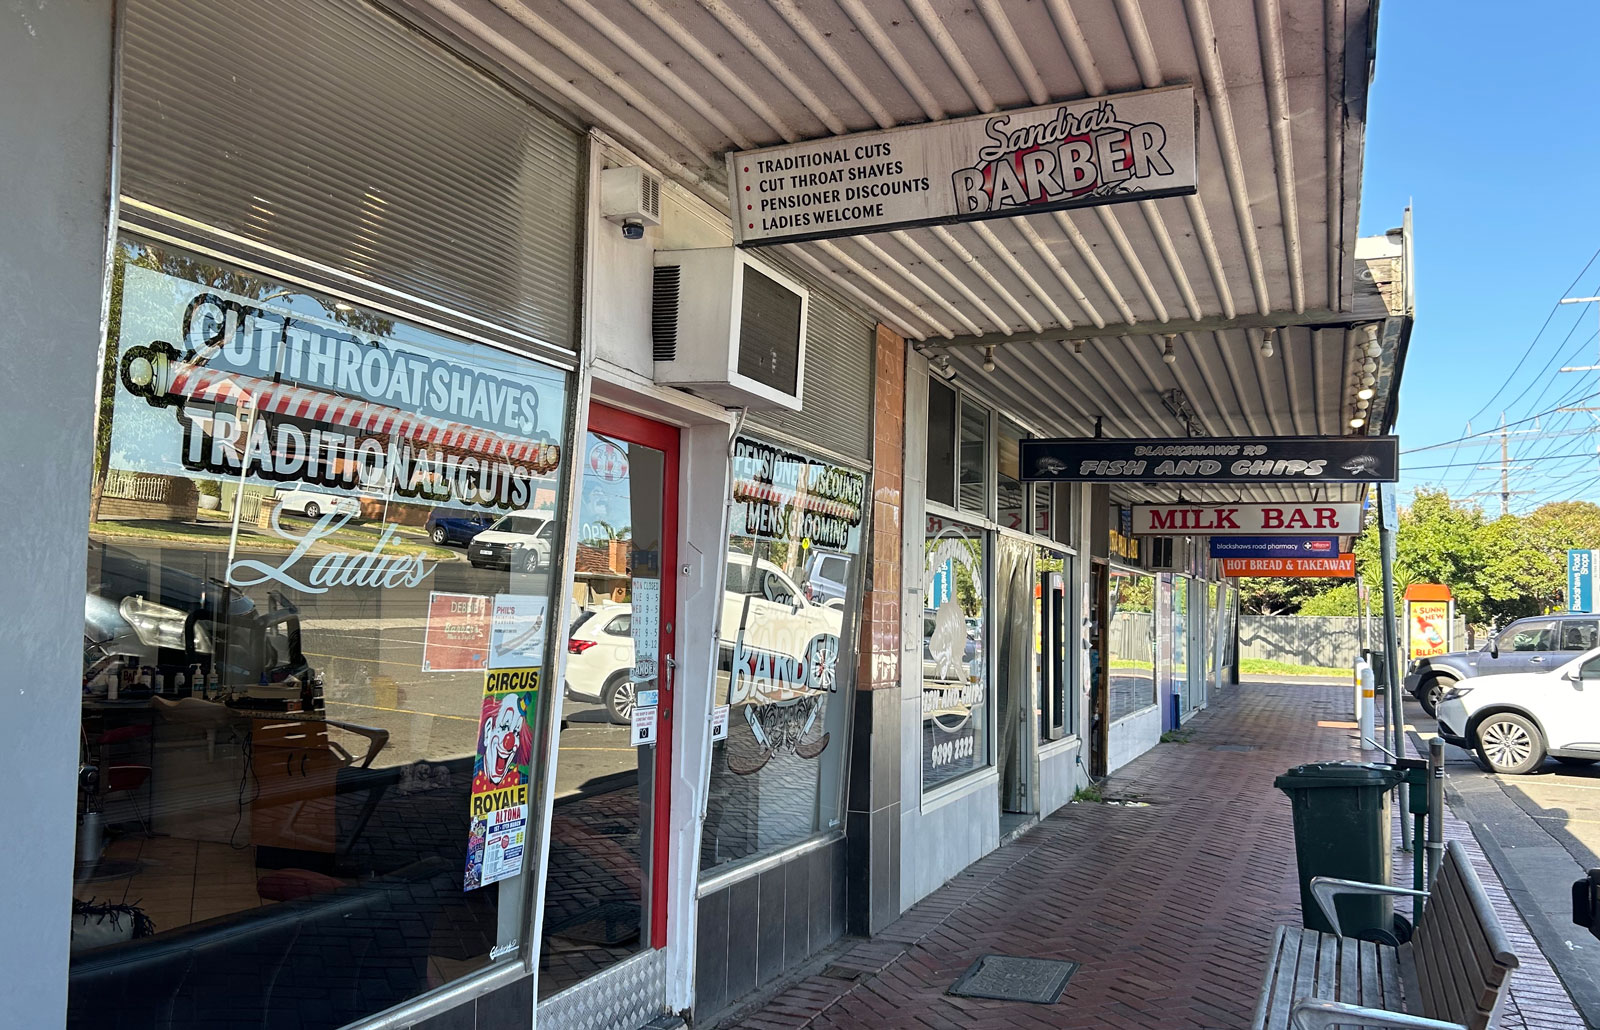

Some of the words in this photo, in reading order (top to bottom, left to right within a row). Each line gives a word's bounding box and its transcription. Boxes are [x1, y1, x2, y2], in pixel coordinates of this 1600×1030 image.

[979, 100, 1117, 162] Sandra's
[757, 149, 850, 174] TRADITIONAL
[855, 142, 891, 160] CUTS
[952, 122, 1175, 215] BARBER
[759, 178, 785, 193] CUT
[790, 169, 845, 189] THROAT
[848, 161, 903, 181] SHAVES
[761, 190, 841, 212] PENSIONER
[845, 177, 930, 201] DISCOUNTS
[762, 213, 811, 231] LADIES
[813, 203, 884, 224] WELCOME
[186, 297, 282, 372] CUT
[286, 324, 429, 407] THROAT
[430, 366, 537, 435] SHAVES
[182, 406, 449, 496] TRADITIONAL
[457, 455, 530, 507] CUTS
[1135, 445, 1240, 456] BLACKSHAWS
[1243, 445, 1268, 456] RD
[735, 440, 808, 490] PENSIONER
[808, 462, 863, 504] DISCOUNTS
[1080, 460, 1147, 476] FISH
[1154, 460, 1222, 476] AND
[1231, 459, 1328, 476] CHIPS
[747, 500, 786, 535] MENS
[787, 508, 848, 547] GROOMING
[1149, 508, 1241, 529] MILK
[1261, 508, 1340, 530] BAR
[229, 479, 438, 594] Ladies
[1267, 543, 1299, 551] pharmacy
[1227, 559, 1246, 570] HOT
[1250, 559, 1283, 570] BREAD
[1286, 559, 1294, 570] &
[1297, 559, 1352, 571] TAKEAWAY
[1572, 553, 1581, 571] Road
[1580, 553, 1590, 575] Shops
[1572, 573, 1581, 611] Blackshaws
[496, 606, 516, 615] PHIL'S
[1419, 607, 1446, 615] SUNNY
[729, 624, 841, 706] BARBER
[1415, 648, 1444, 657] BLEND
[486, 671, 538, 693] CIRCUS
[941, 687, 960, 709] AND
[961, 683, 984, 705] CHIPS
[931, 741, 953, 769] 9399
[473, 787, 526, 816] ROYALE
[495, 807, 521, 824] ALTONA
